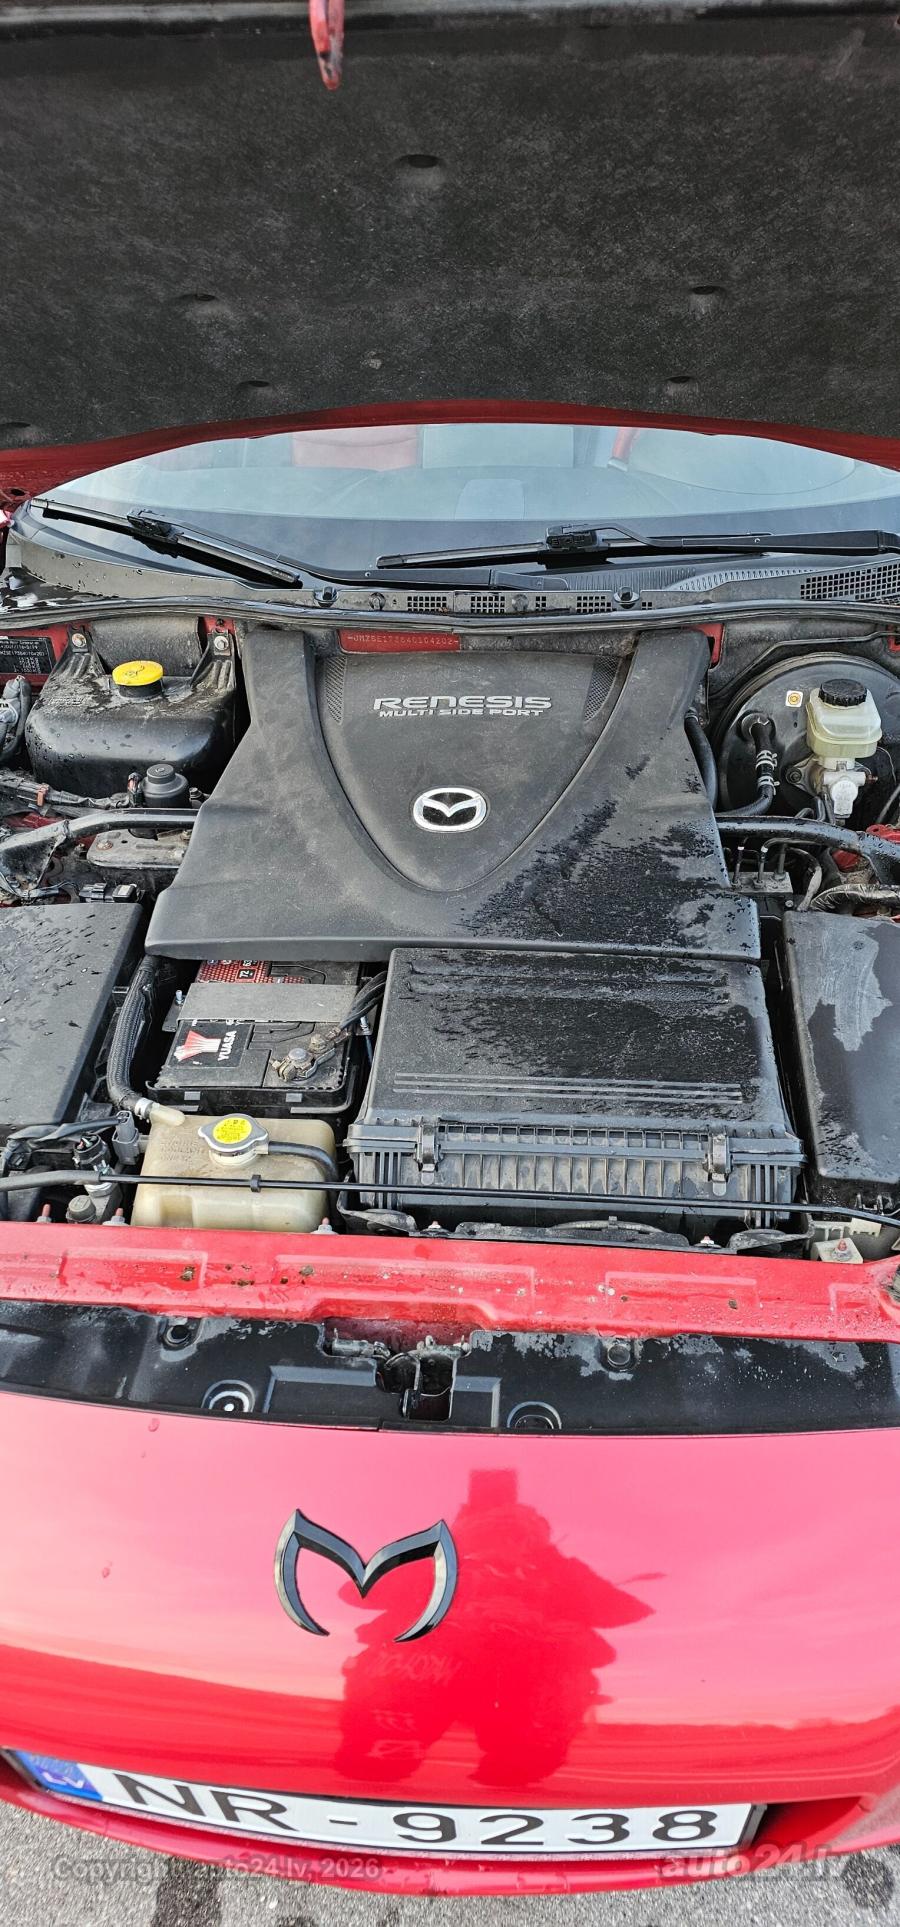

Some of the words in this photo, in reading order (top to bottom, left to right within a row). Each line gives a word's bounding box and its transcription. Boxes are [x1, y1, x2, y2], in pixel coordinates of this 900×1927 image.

[373, 695, 552, 710] RENESIS
[379, 709, 434, 718] MULTI
[439, 708, 484, 716] SIDE
[489, 708, 544, 717] PORT
[217, 1030, 238, 1061] YUASA
[42, 1771, 85, 1789] LV
